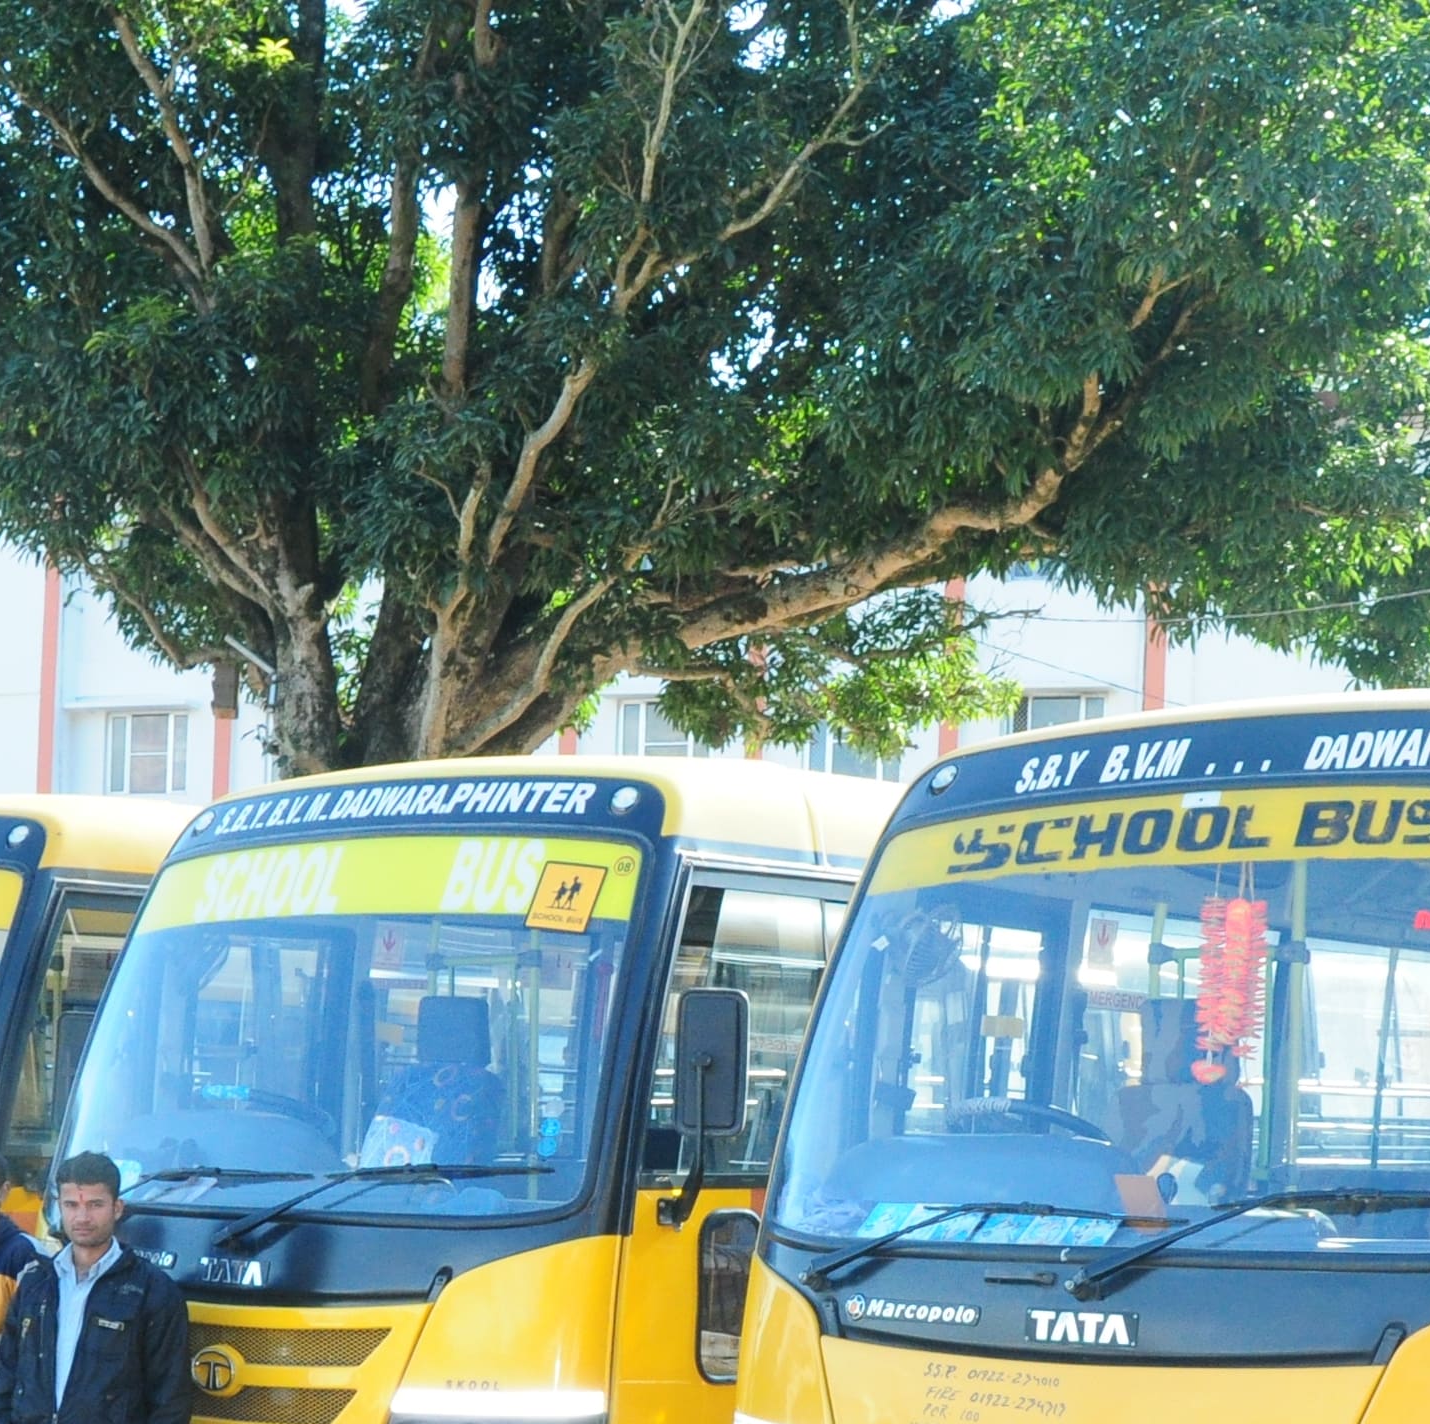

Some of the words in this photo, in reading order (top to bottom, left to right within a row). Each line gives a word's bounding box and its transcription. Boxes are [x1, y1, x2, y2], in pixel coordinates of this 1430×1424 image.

[1015, 755, 1087, 794] S.B.Y
[1098, 738, 1192, 784] B.V.M
[946, 804, 1270, 876] SCHOOL
[195, 844, 347, 924] SCHOOL
[440, 838, 548, 912] BUS
[200, 1256, 263, 1287] TATA
[865, 1298, 978, 1325] Marcopolo
[1030, 1310, 1131, 1346] TATA
[925, 1386, 962, 1402] FIRE
